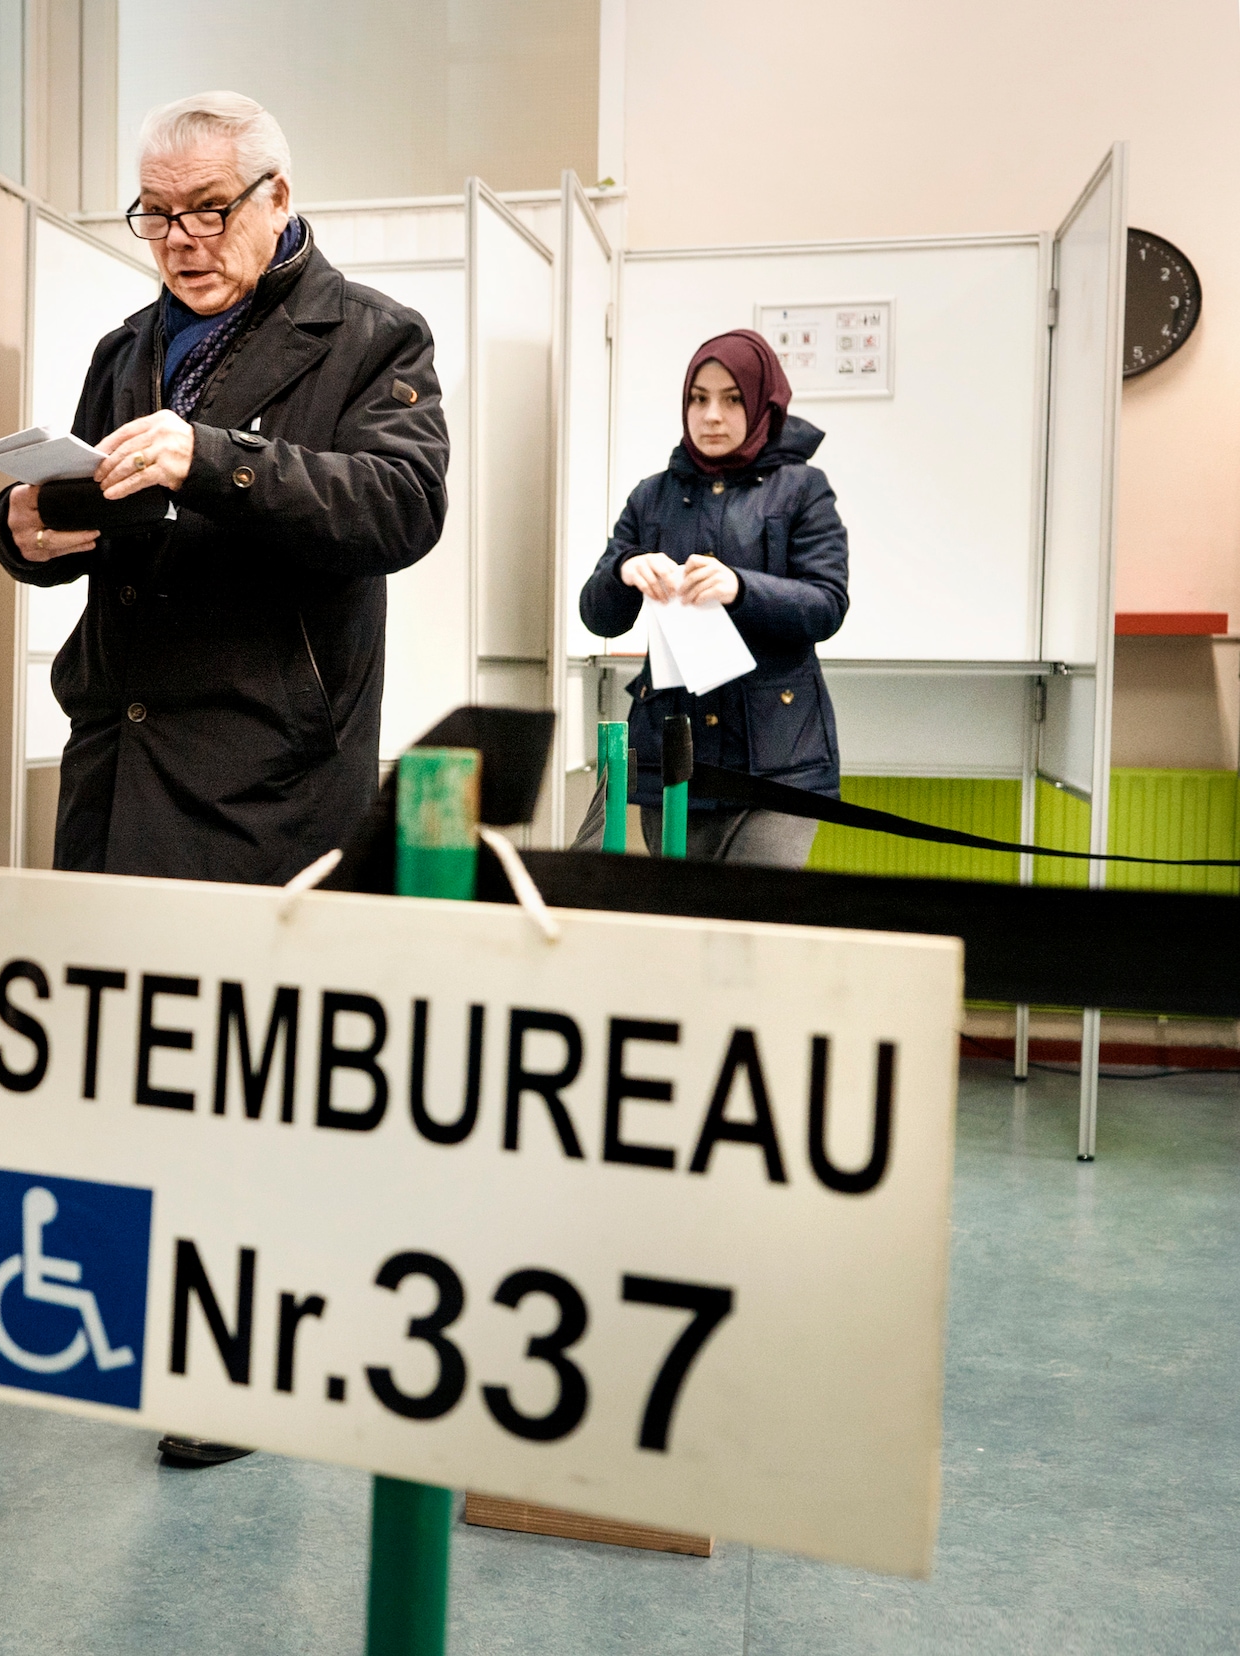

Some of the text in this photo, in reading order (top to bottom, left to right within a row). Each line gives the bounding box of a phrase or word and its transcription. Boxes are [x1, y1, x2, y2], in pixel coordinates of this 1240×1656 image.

[1140, 249, 1146, 261] 1
[1161, 267, 1170, 281] 2
[1169, 295, 1180, 309] 3
[1161, 324, 1170, 336] 4
[1133, 346, 1143, 359] 5
